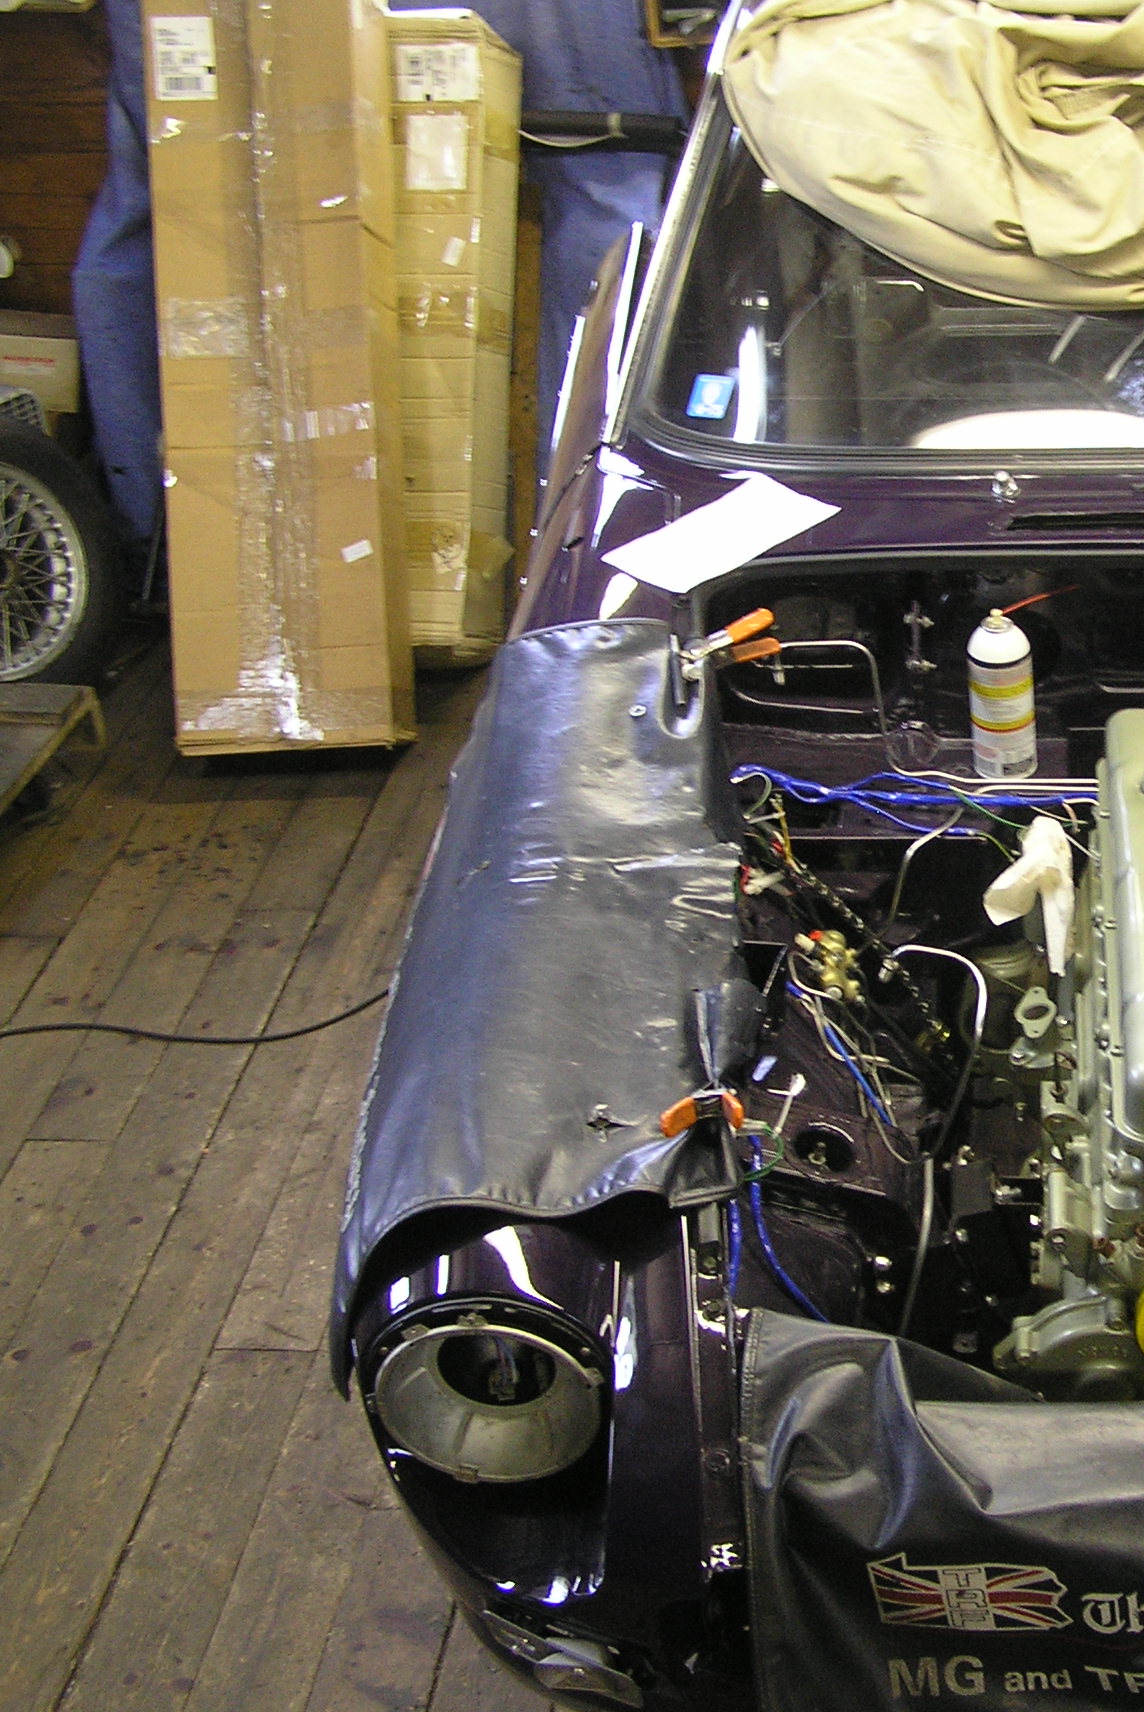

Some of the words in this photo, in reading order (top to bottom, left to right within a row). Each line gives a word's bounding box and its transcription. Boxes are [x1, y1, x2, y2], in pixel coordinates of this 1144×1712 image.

[943, 1568, 991, 1628] TRF
[888, 1655, 987, 1698] MG
[1004, 1668, 1073, 1693] and
